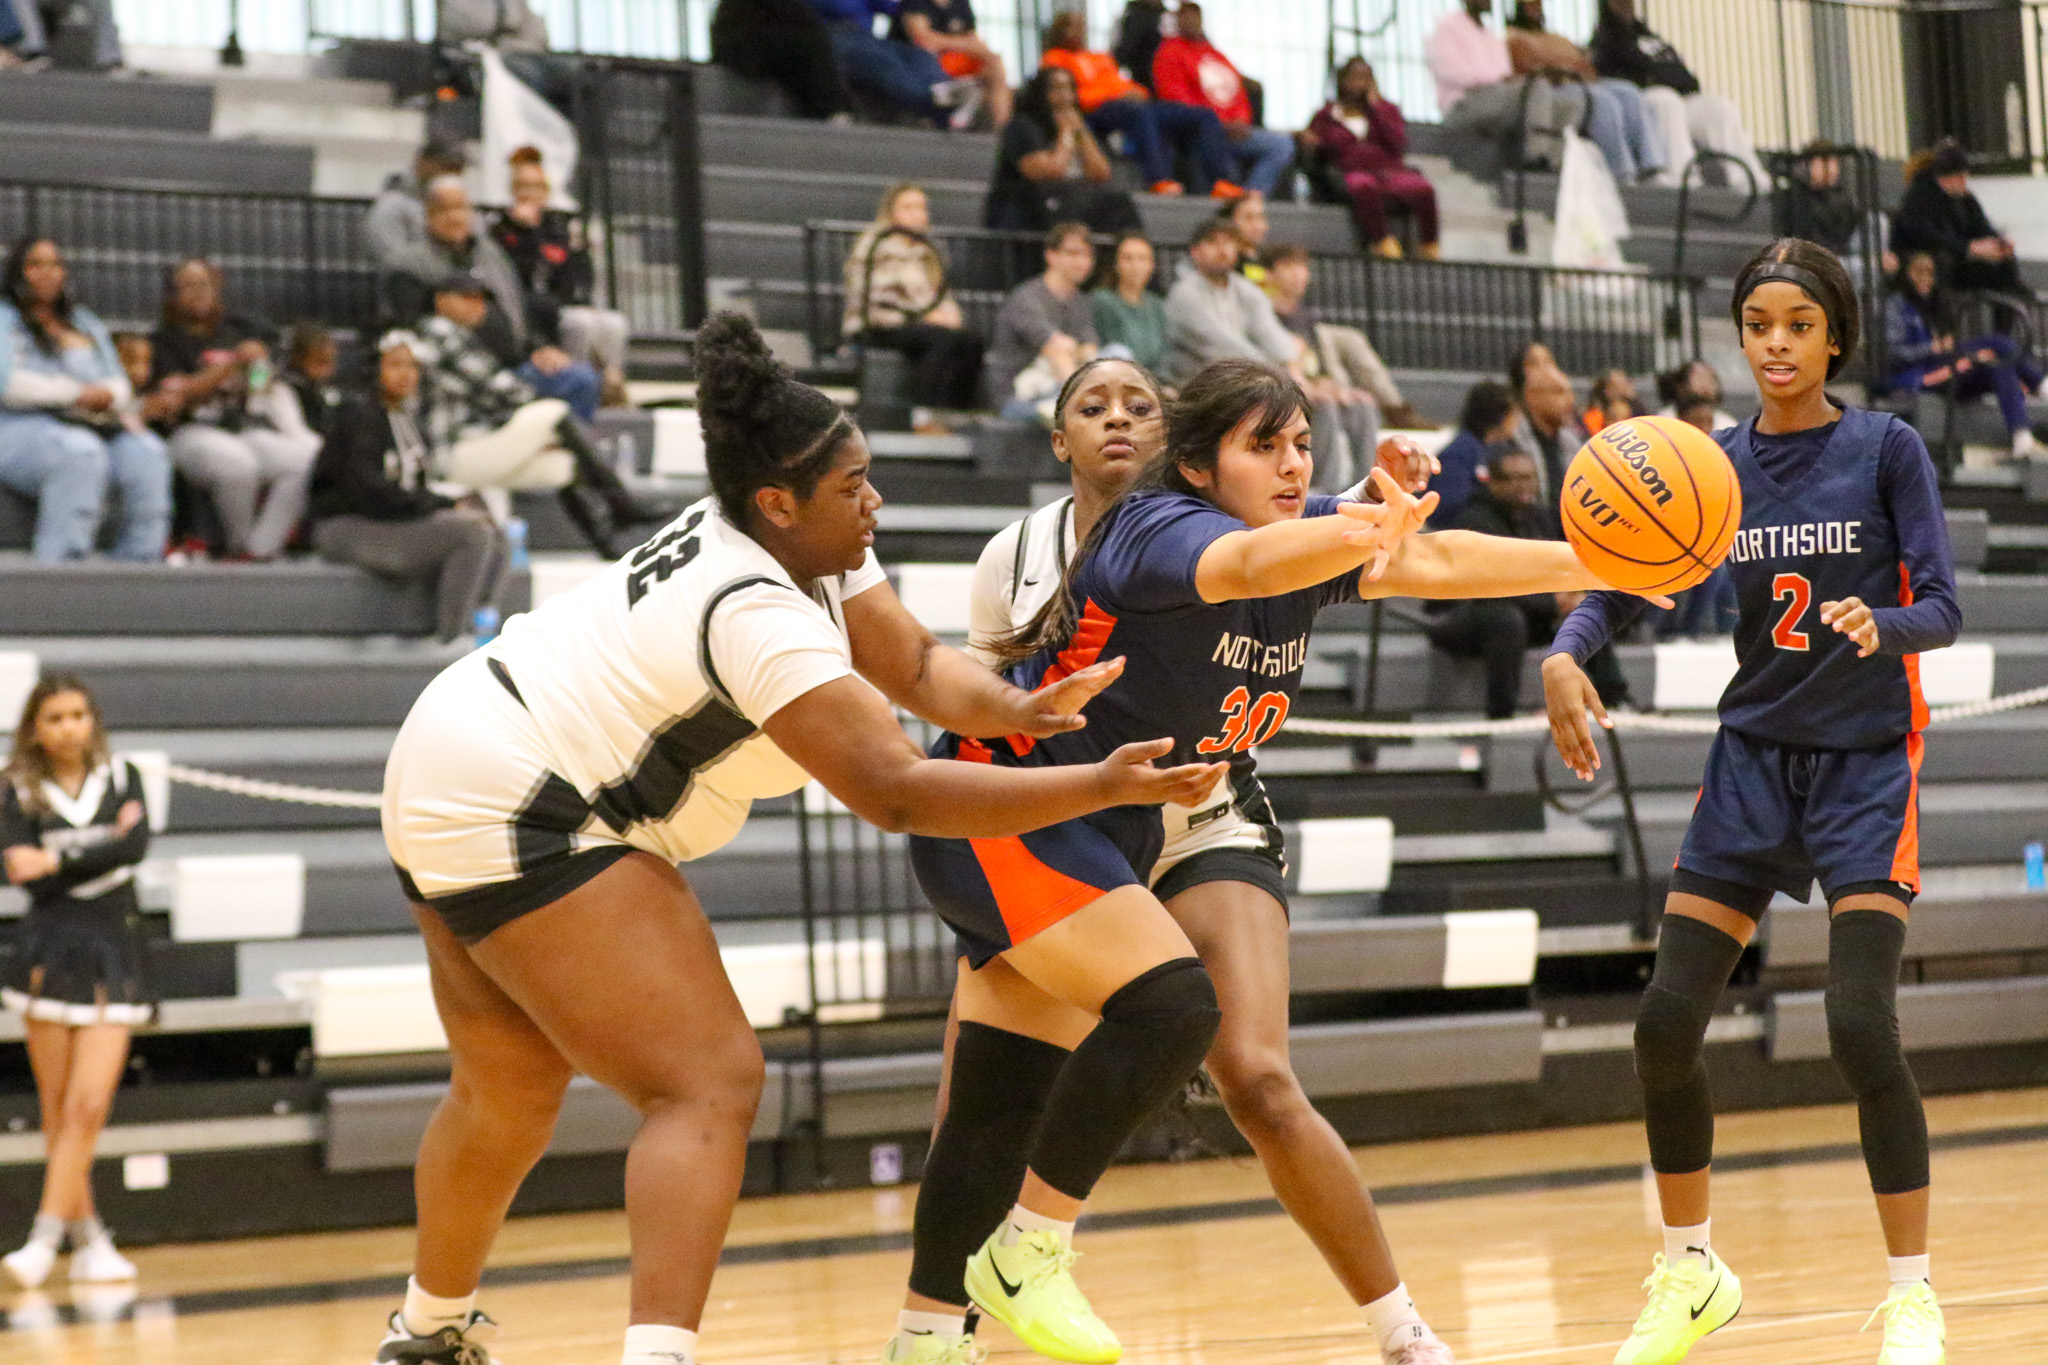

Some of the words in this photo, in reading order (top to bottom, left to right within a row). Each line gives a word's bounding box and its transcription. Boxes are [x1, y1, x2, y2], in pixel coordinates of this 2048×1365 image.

[1601, 423, 1673, 508] Wilson
[1570, 475, 1620, 527] EVO
[1771, 572, 1812, 651] 2
[1211, 631, 1306, 678] NOTHSIDE
[1196, 685, 1290, 754] 30
